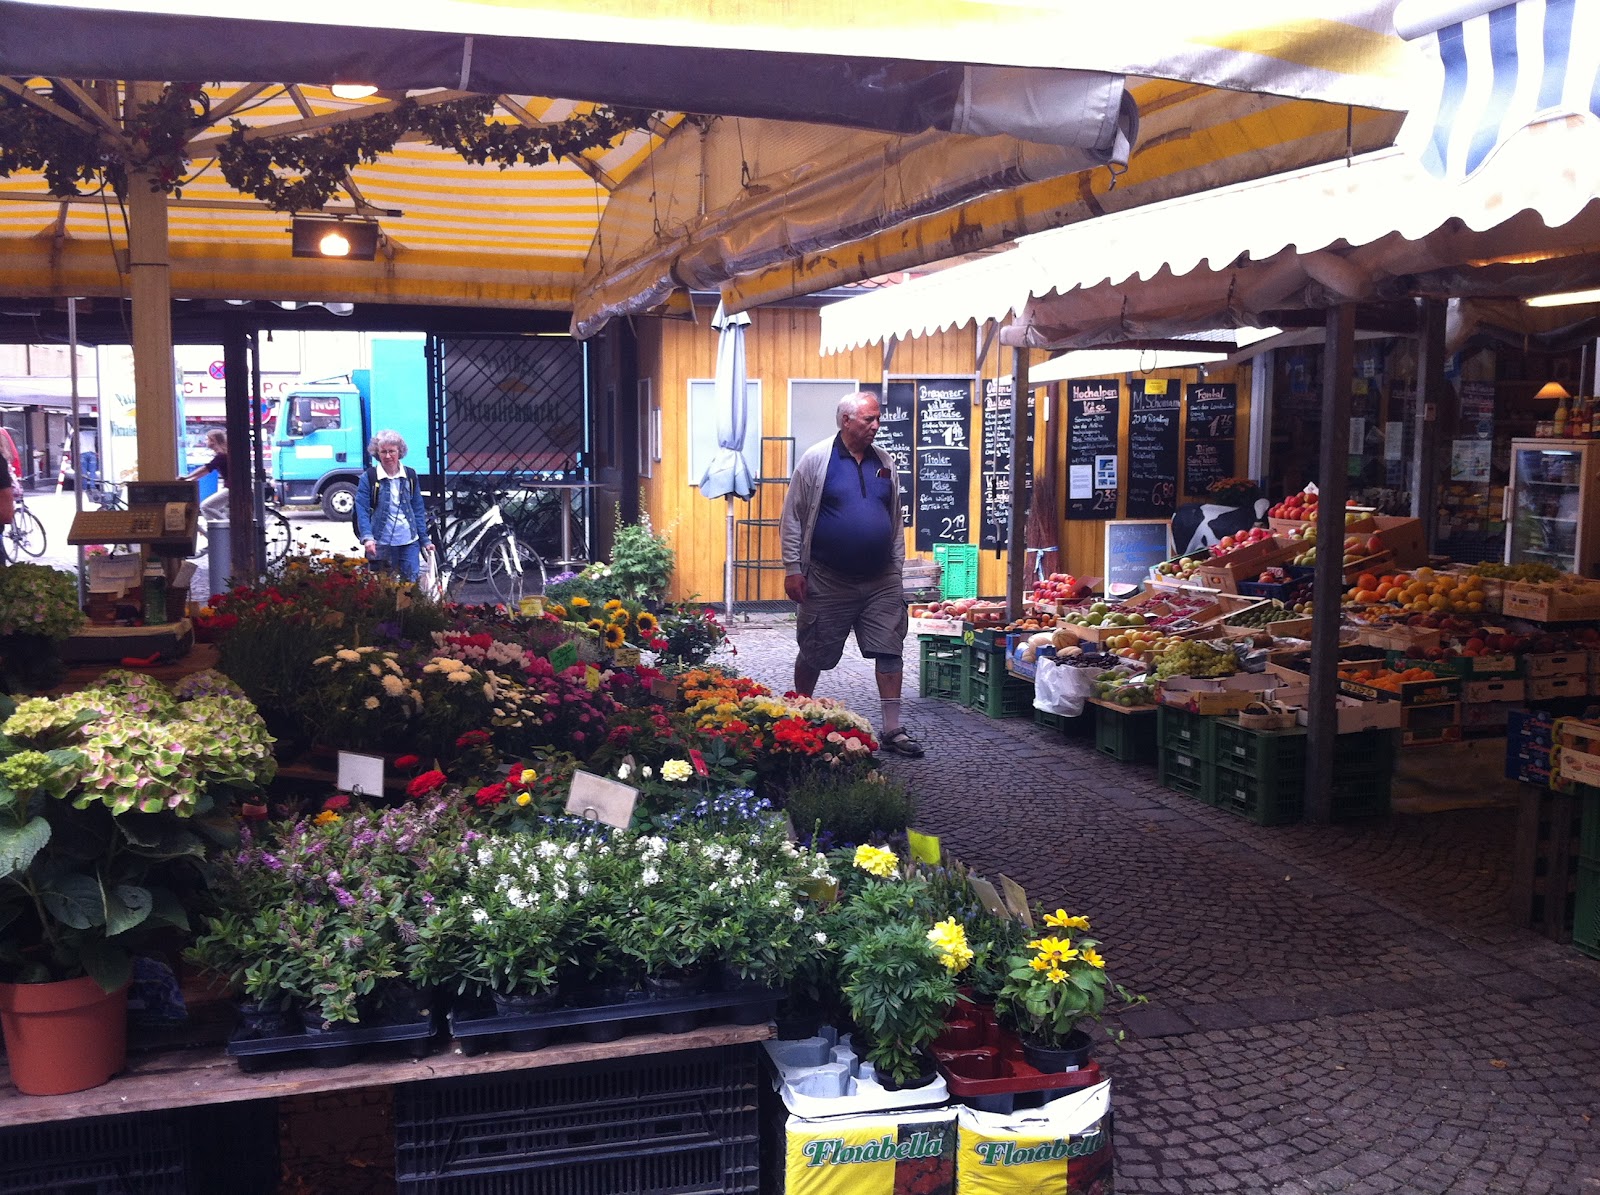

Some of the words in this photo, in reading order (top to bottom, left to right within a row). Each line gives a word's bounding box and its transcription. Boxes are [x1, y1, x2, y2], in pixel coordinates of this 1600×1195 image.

[920, 386, 967, 400] Bregenzer-
[1073, 385, 1117, 401] Hochalpen
[1083, 401, 1107, 413] Käse
[921, 453, 950, 464] Tiroler
[920, 468, 957, 480] Steinsalz
[932, 481, 951, 491] Käse
[802, 1132, 943, 1167] Florabella
